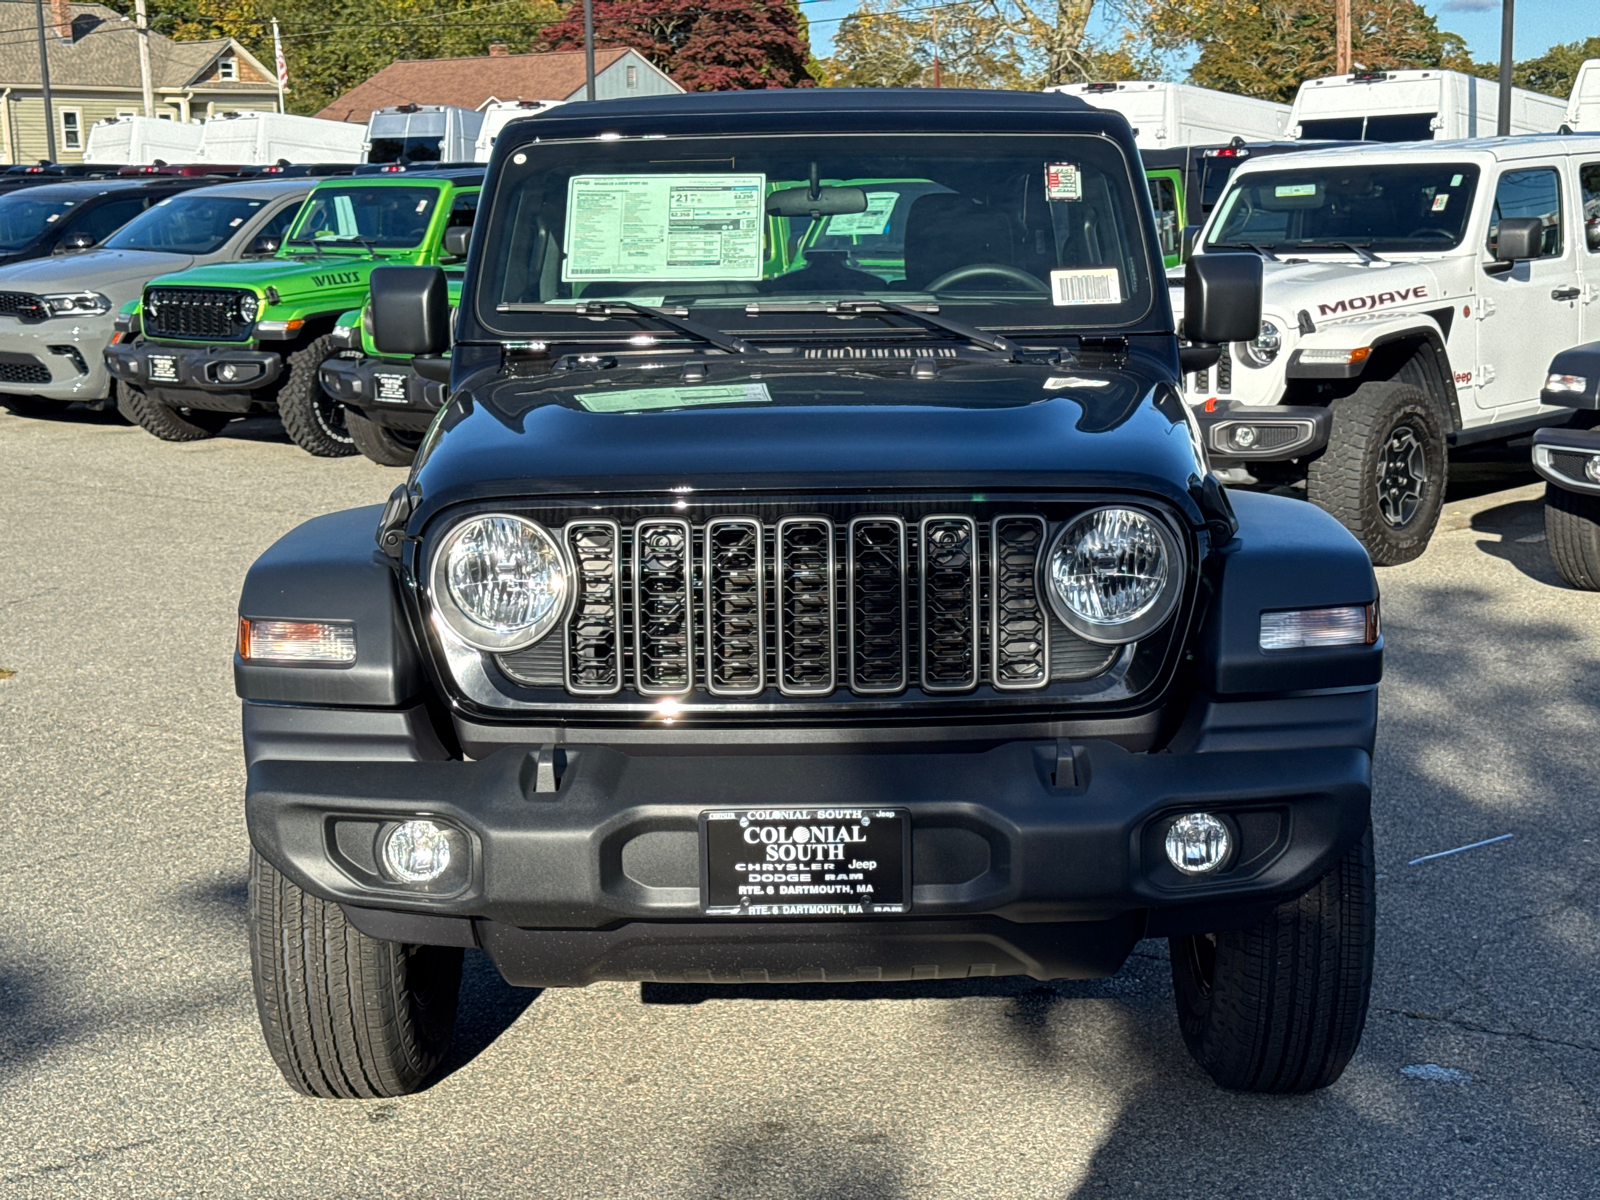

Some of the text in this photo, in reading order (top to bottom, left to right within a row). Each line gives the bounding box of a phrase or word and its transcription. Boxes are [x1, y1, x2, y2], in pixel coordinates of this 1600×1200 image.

[676, 194, 688, 202] 21
[311, 271, 361, 287] WILLYS
[1317, 285, 1428, 317] MOJAVE
[747, 810, 863, 820] COLONIAL SOUTH
[876, 810, 896, 818] Jeep
[743, 825, 867, 844] COLONIAL
[766, 843, 845, 862] SOUTH
[735, 863, 836, 872] CHRYSLER
[848, 859, 878, 871] Jeep
[748, 872, 864, 882] DODGE RAM
[738, 884, 874, 895] RTE. 6 DARTMOUTH, MA
[748, 906, 771, 915] RTE.
[772, 906, 779, 915] 6
[783, 905, 847, 915] DARTMOUTH,
[848, 905, 864, 914] MA
